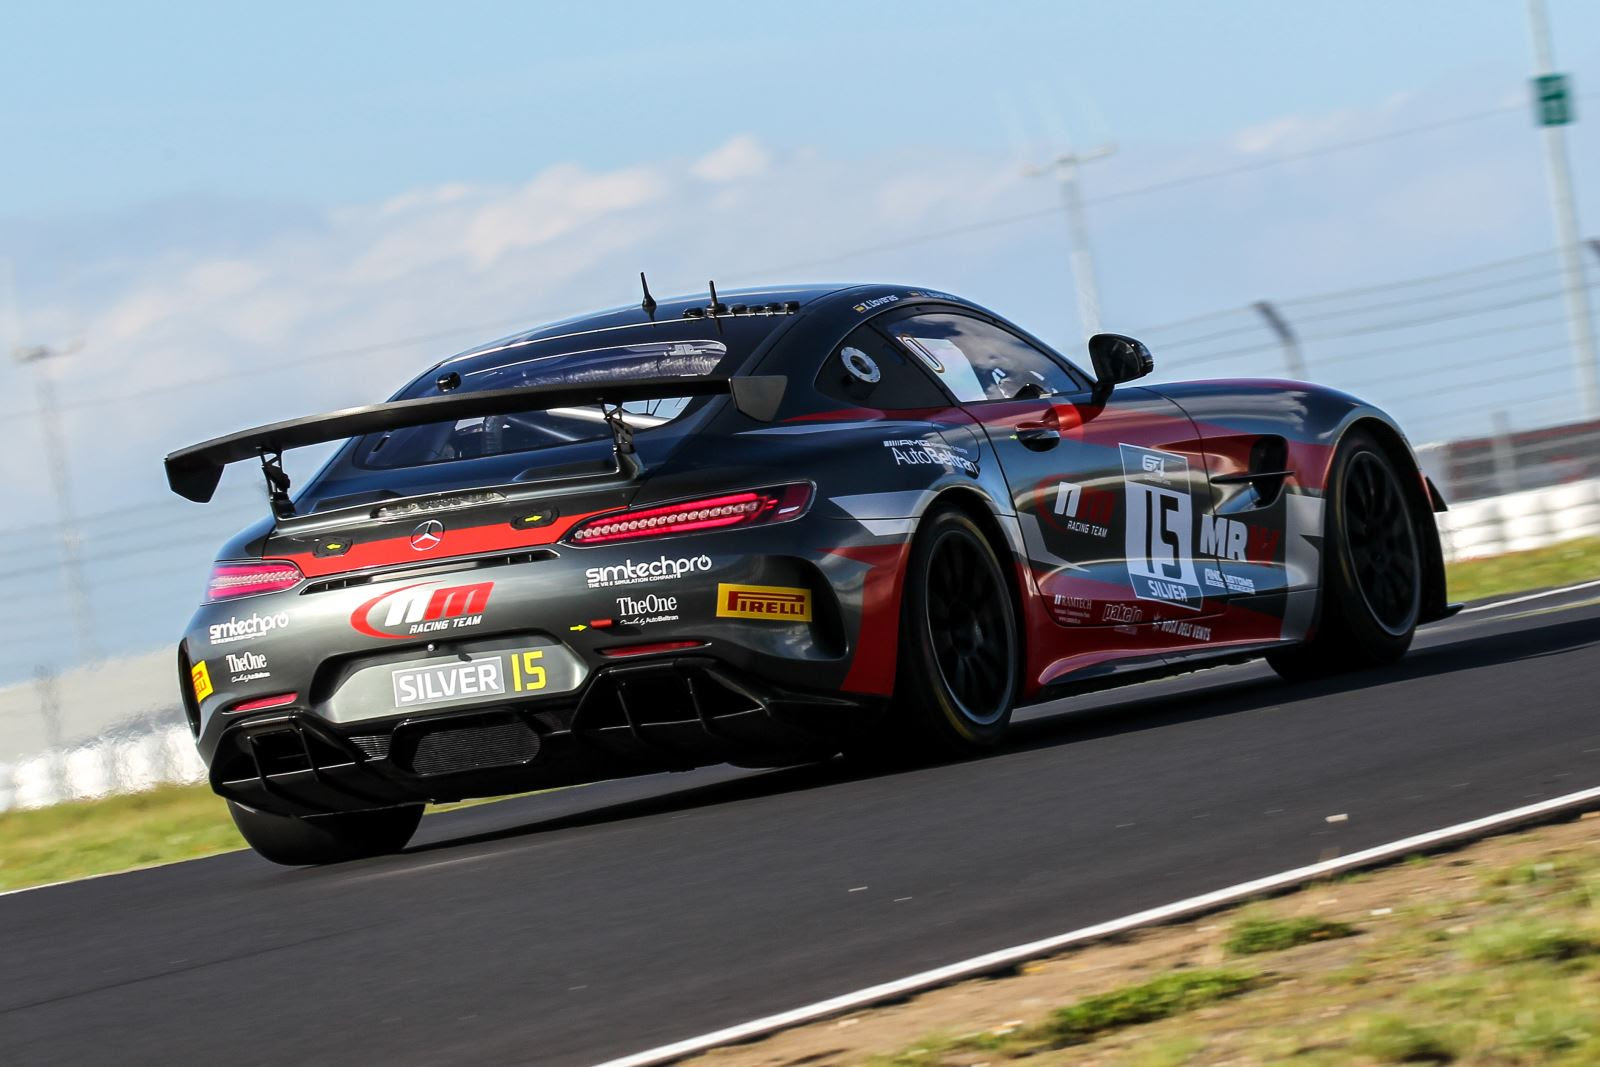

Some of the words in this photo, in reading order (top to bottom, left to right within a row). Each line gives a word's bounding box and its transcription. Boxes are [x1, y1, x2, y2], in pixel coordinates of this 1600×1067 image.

[892, 447, 979, 474] AutoBeltran
[1067, 520, 1090, 534] RACING
[1091, 525, 1108, 538] TEAM
[1145, 488, 1183, 580] 15
[586, 554, 712, 584] simtechpro
[614, 577, 649, 586] SIMULATION
[649, 573, 678, 582] COMPANY
[1148, 580, 1188, 602] SILVER
[616, 593, 678, 616] TheOne
[728, 591, 805, 616] PIRELLI
[409, 619, 450, 635] RACING
[453, 614, 483, 628] TEAM
[226, 651, 268, 673] TheOne
[397, 664, 500, 702] SILVER
[511, 650, 546, 692] 15
